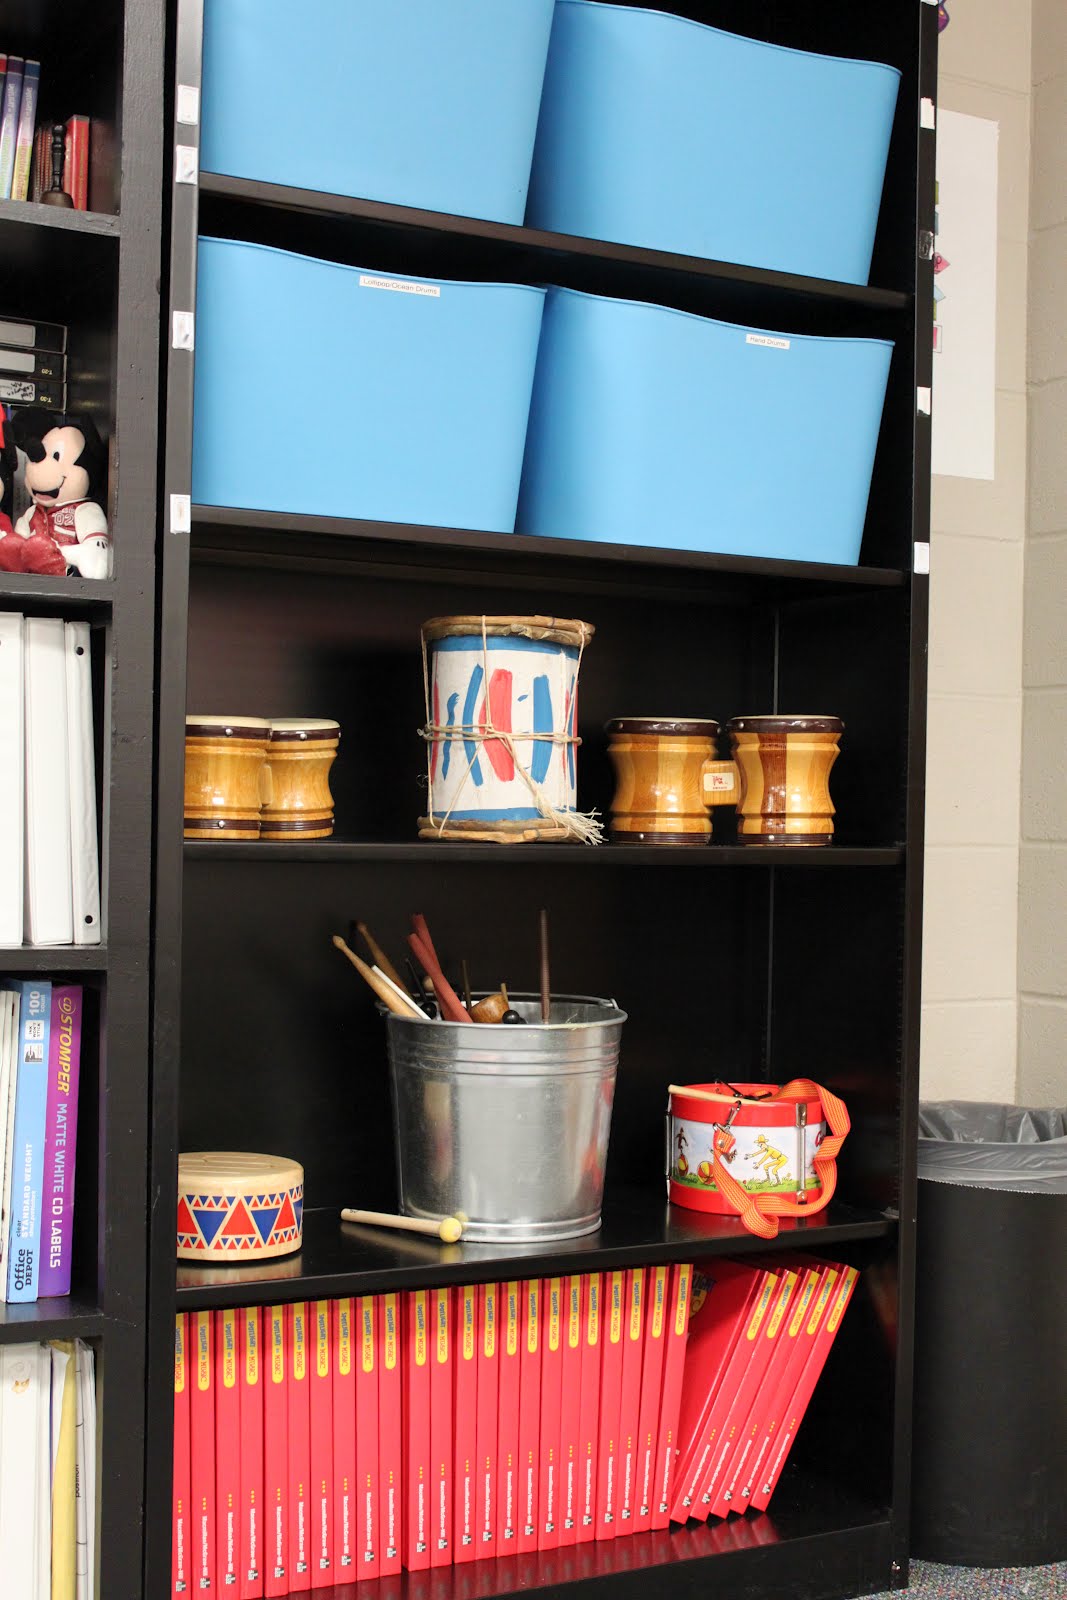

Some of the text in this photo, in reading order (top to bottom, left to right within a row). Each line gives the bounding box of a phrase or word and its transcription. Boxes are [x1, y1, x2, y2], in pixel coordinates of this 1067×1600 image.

[416, 286, 437, 294] Drums
[30, 991, 40, 1016] 100
[58, 997, 73, 1092] CD STOMPER
[49, 1103, 68, 1268] MATTE WHITE CD LABELS
[14, 1249, 26, 1291] Office
